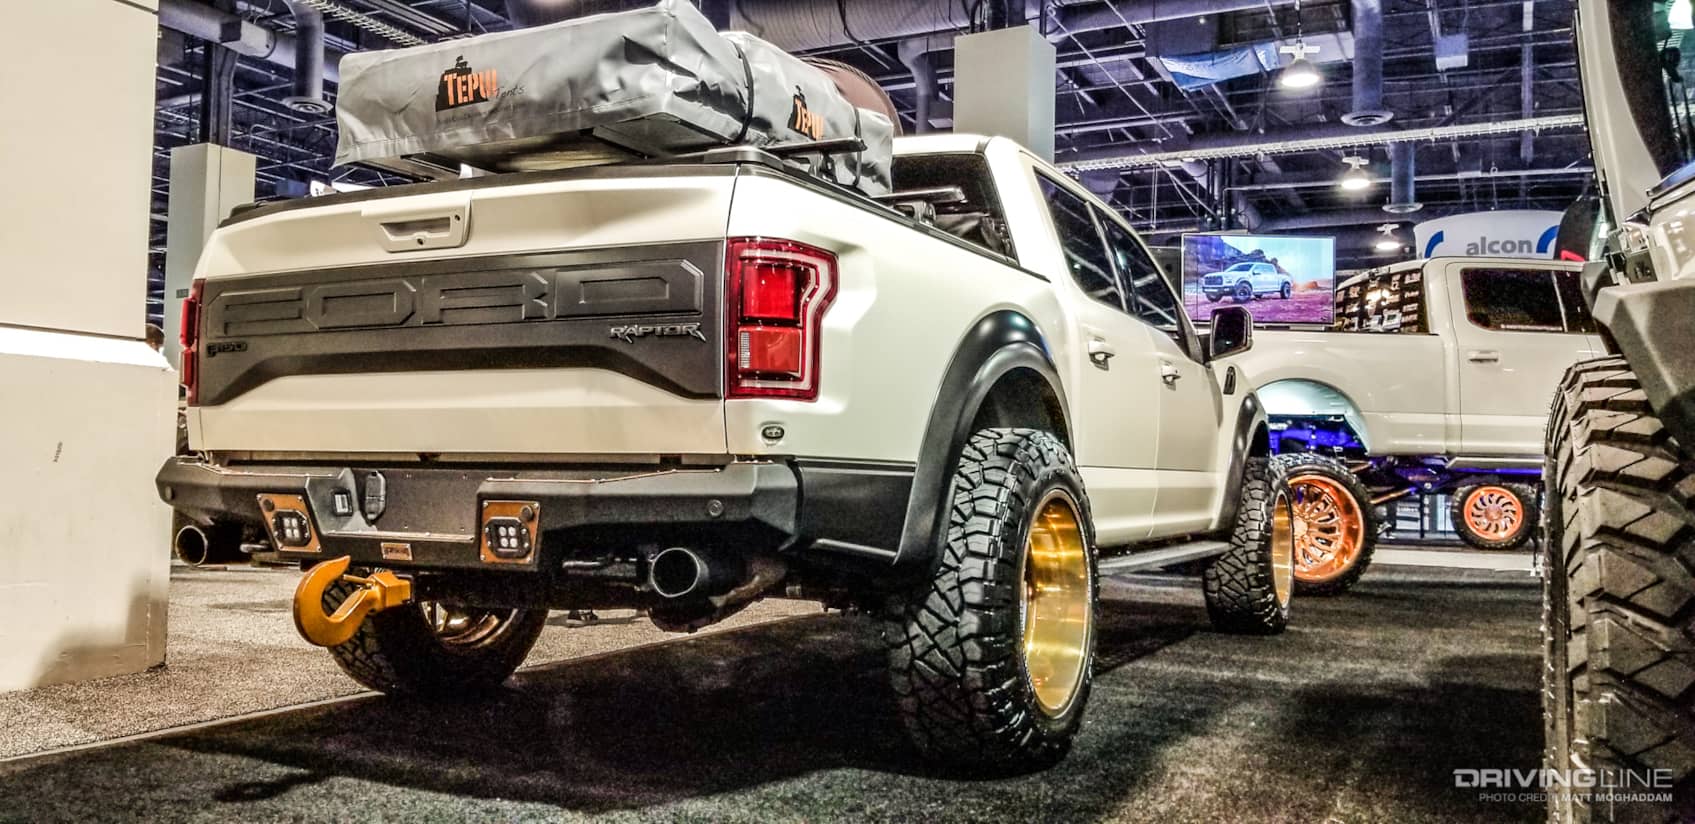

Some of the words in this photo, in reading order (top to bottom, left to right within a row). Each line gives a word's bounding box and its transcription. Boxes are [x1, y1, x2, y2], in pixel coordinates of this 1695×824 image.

[1466, 236, 1533, 256] alcon
[206, 259, 704, 338] FORD
[609, 322, 706, 343] RAPTOR
